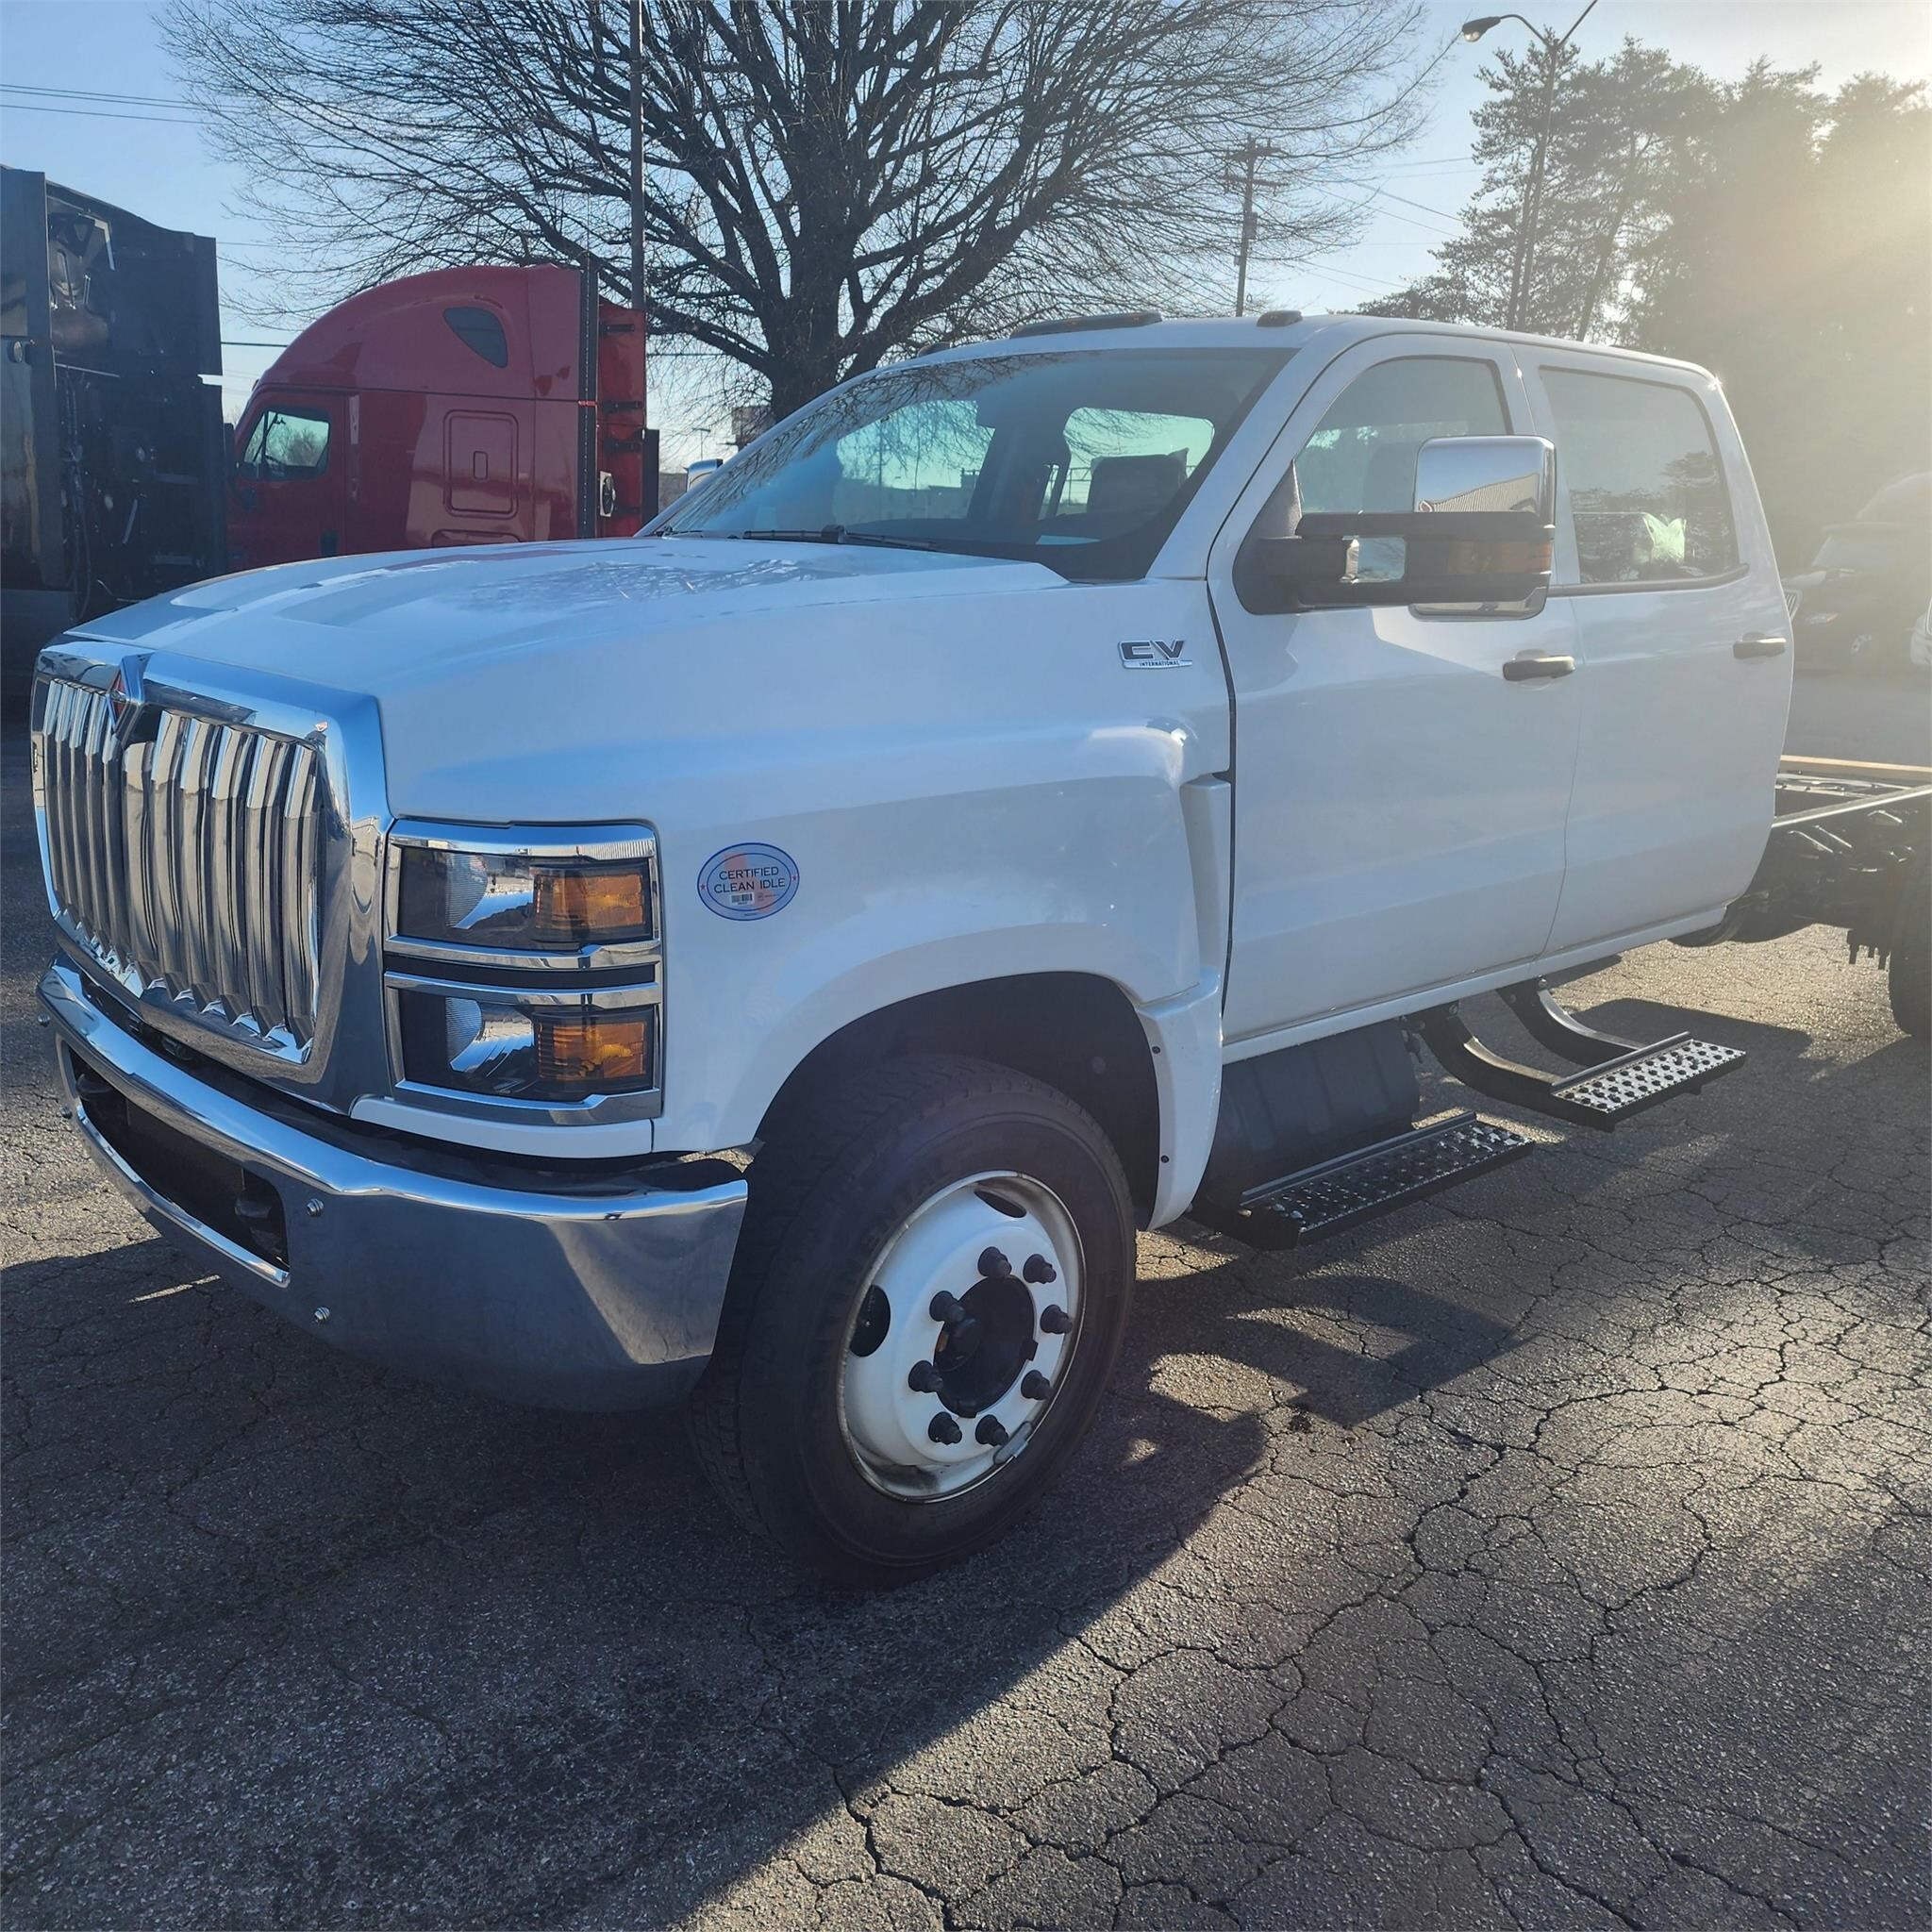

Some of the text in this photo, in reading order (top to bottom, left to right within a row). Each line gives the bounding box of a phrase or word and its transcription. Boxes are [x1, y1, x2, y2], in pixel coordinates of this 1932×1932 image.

[719, 866, 779, 880] CERTIFIED
[713, 877, 786, 893] CLEAN IDLE
